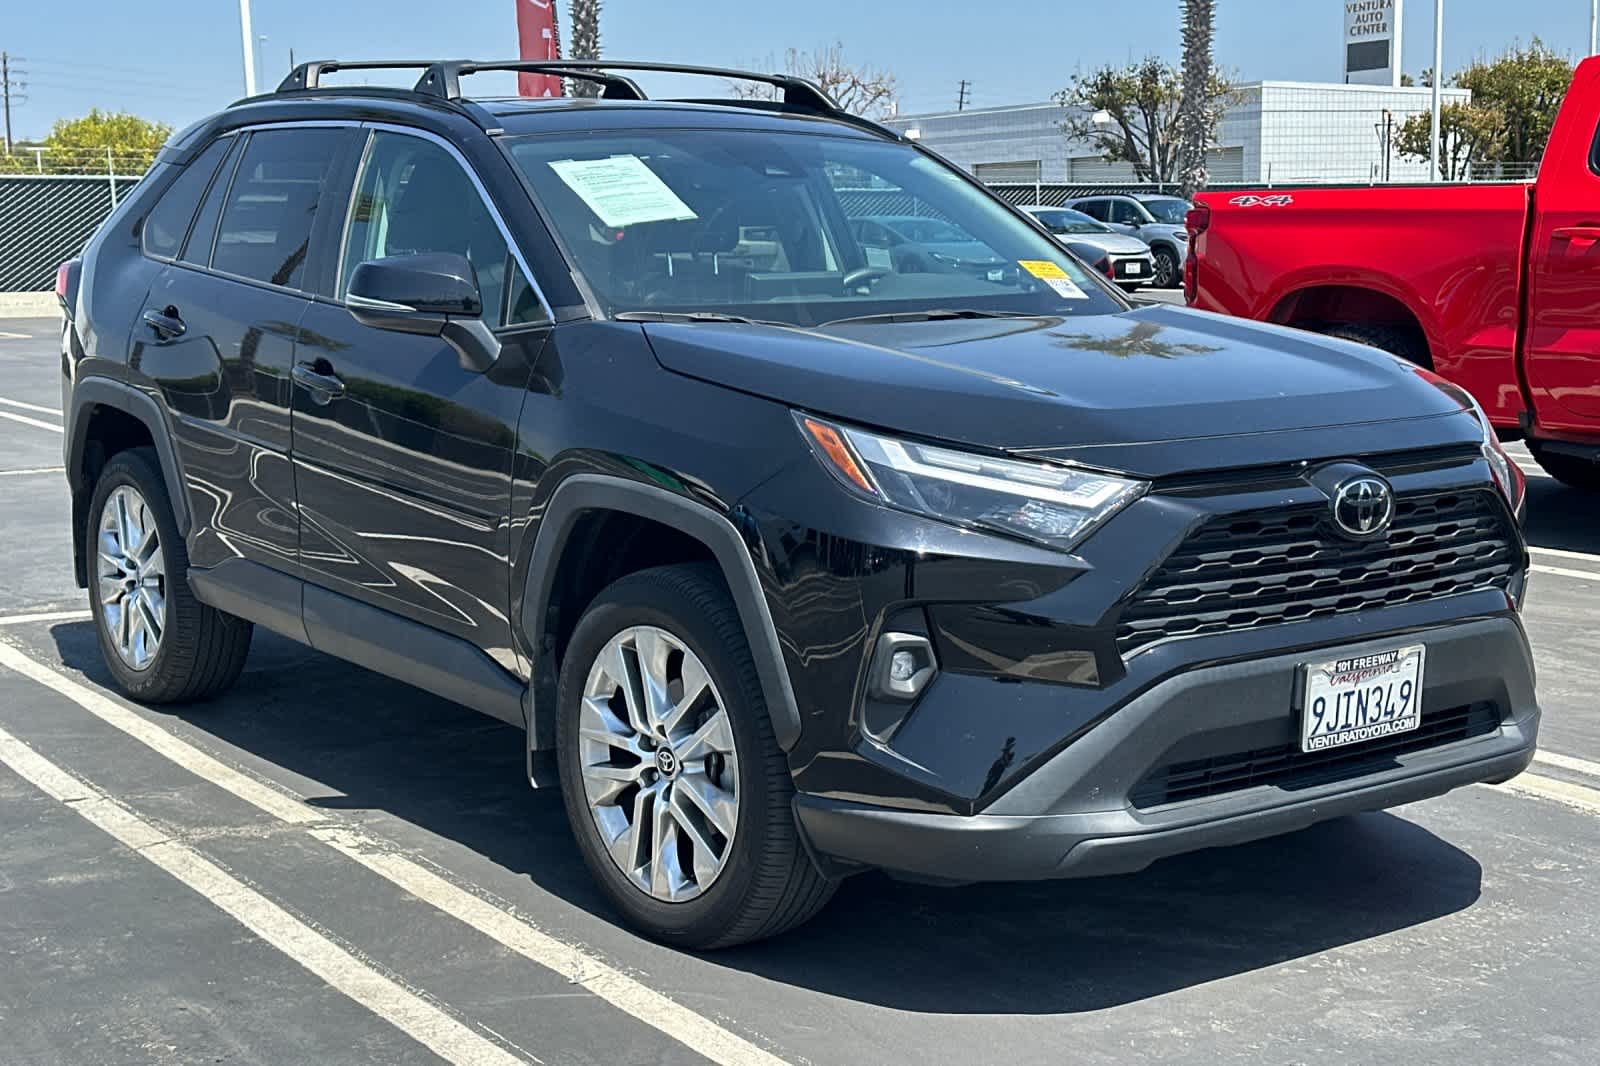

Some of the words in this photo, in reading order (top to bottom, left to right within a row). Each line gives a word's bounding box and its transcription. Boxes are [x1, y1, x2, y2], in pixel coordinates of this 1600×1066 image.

[1346, 0, 1392, 13] VENTURA
[1355, 11, 1383, 24] AUTO
[1350, 22, 1387, 36] CENTER
[1338, 660, 1351, 672] 101
[1353, 652, 1397, 669] FREEWAY
[1311, 680, 1412, 737] 9JIN349
[1309, 717, 1415, 749] VENTURATOYOTA.COM
